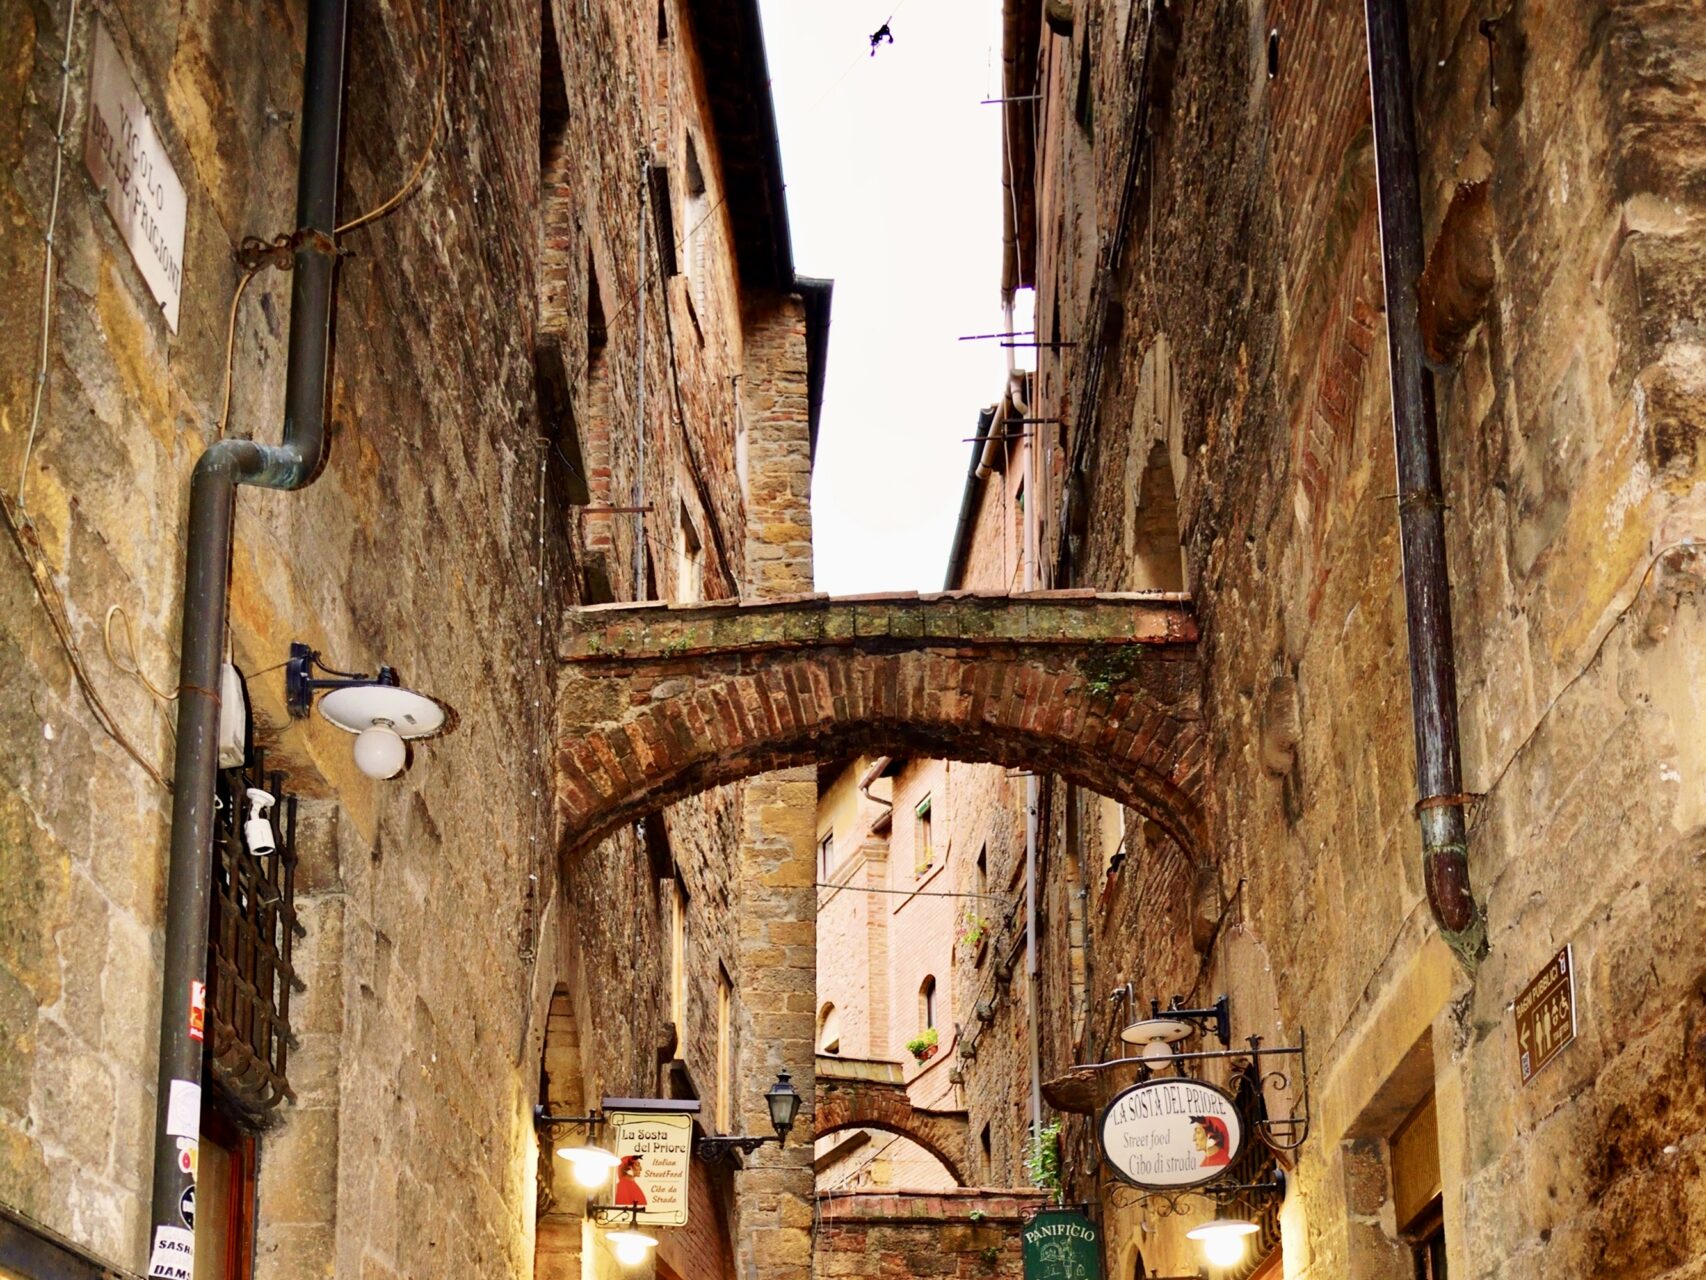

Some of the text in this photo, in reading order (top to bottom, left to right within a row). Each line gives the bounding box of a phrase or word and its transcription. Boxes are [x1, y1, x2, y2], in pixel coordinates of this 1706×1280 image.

[120, 103, 163, 210] VICOLO
[92, 103, 180, 296] DELLE PRIGIONI
[1128, 1088, 1163, 1121] SOSTA
[1164, 1086, 1185, 1115] DEL
[1186, 1087, 1226, 1115] PRIORE
[622, 1129, 668, 1140] La Sosta
[1123, 1128, 1170, 1150] Street food
[633, 1142, 686, 1153] del Priore
[1128, 1150, 1197, 1175] Cibo di strada
[1024, 1224, 1095, 1244] PANIFICIO
[158, 1240, 193, 1255] SASH
